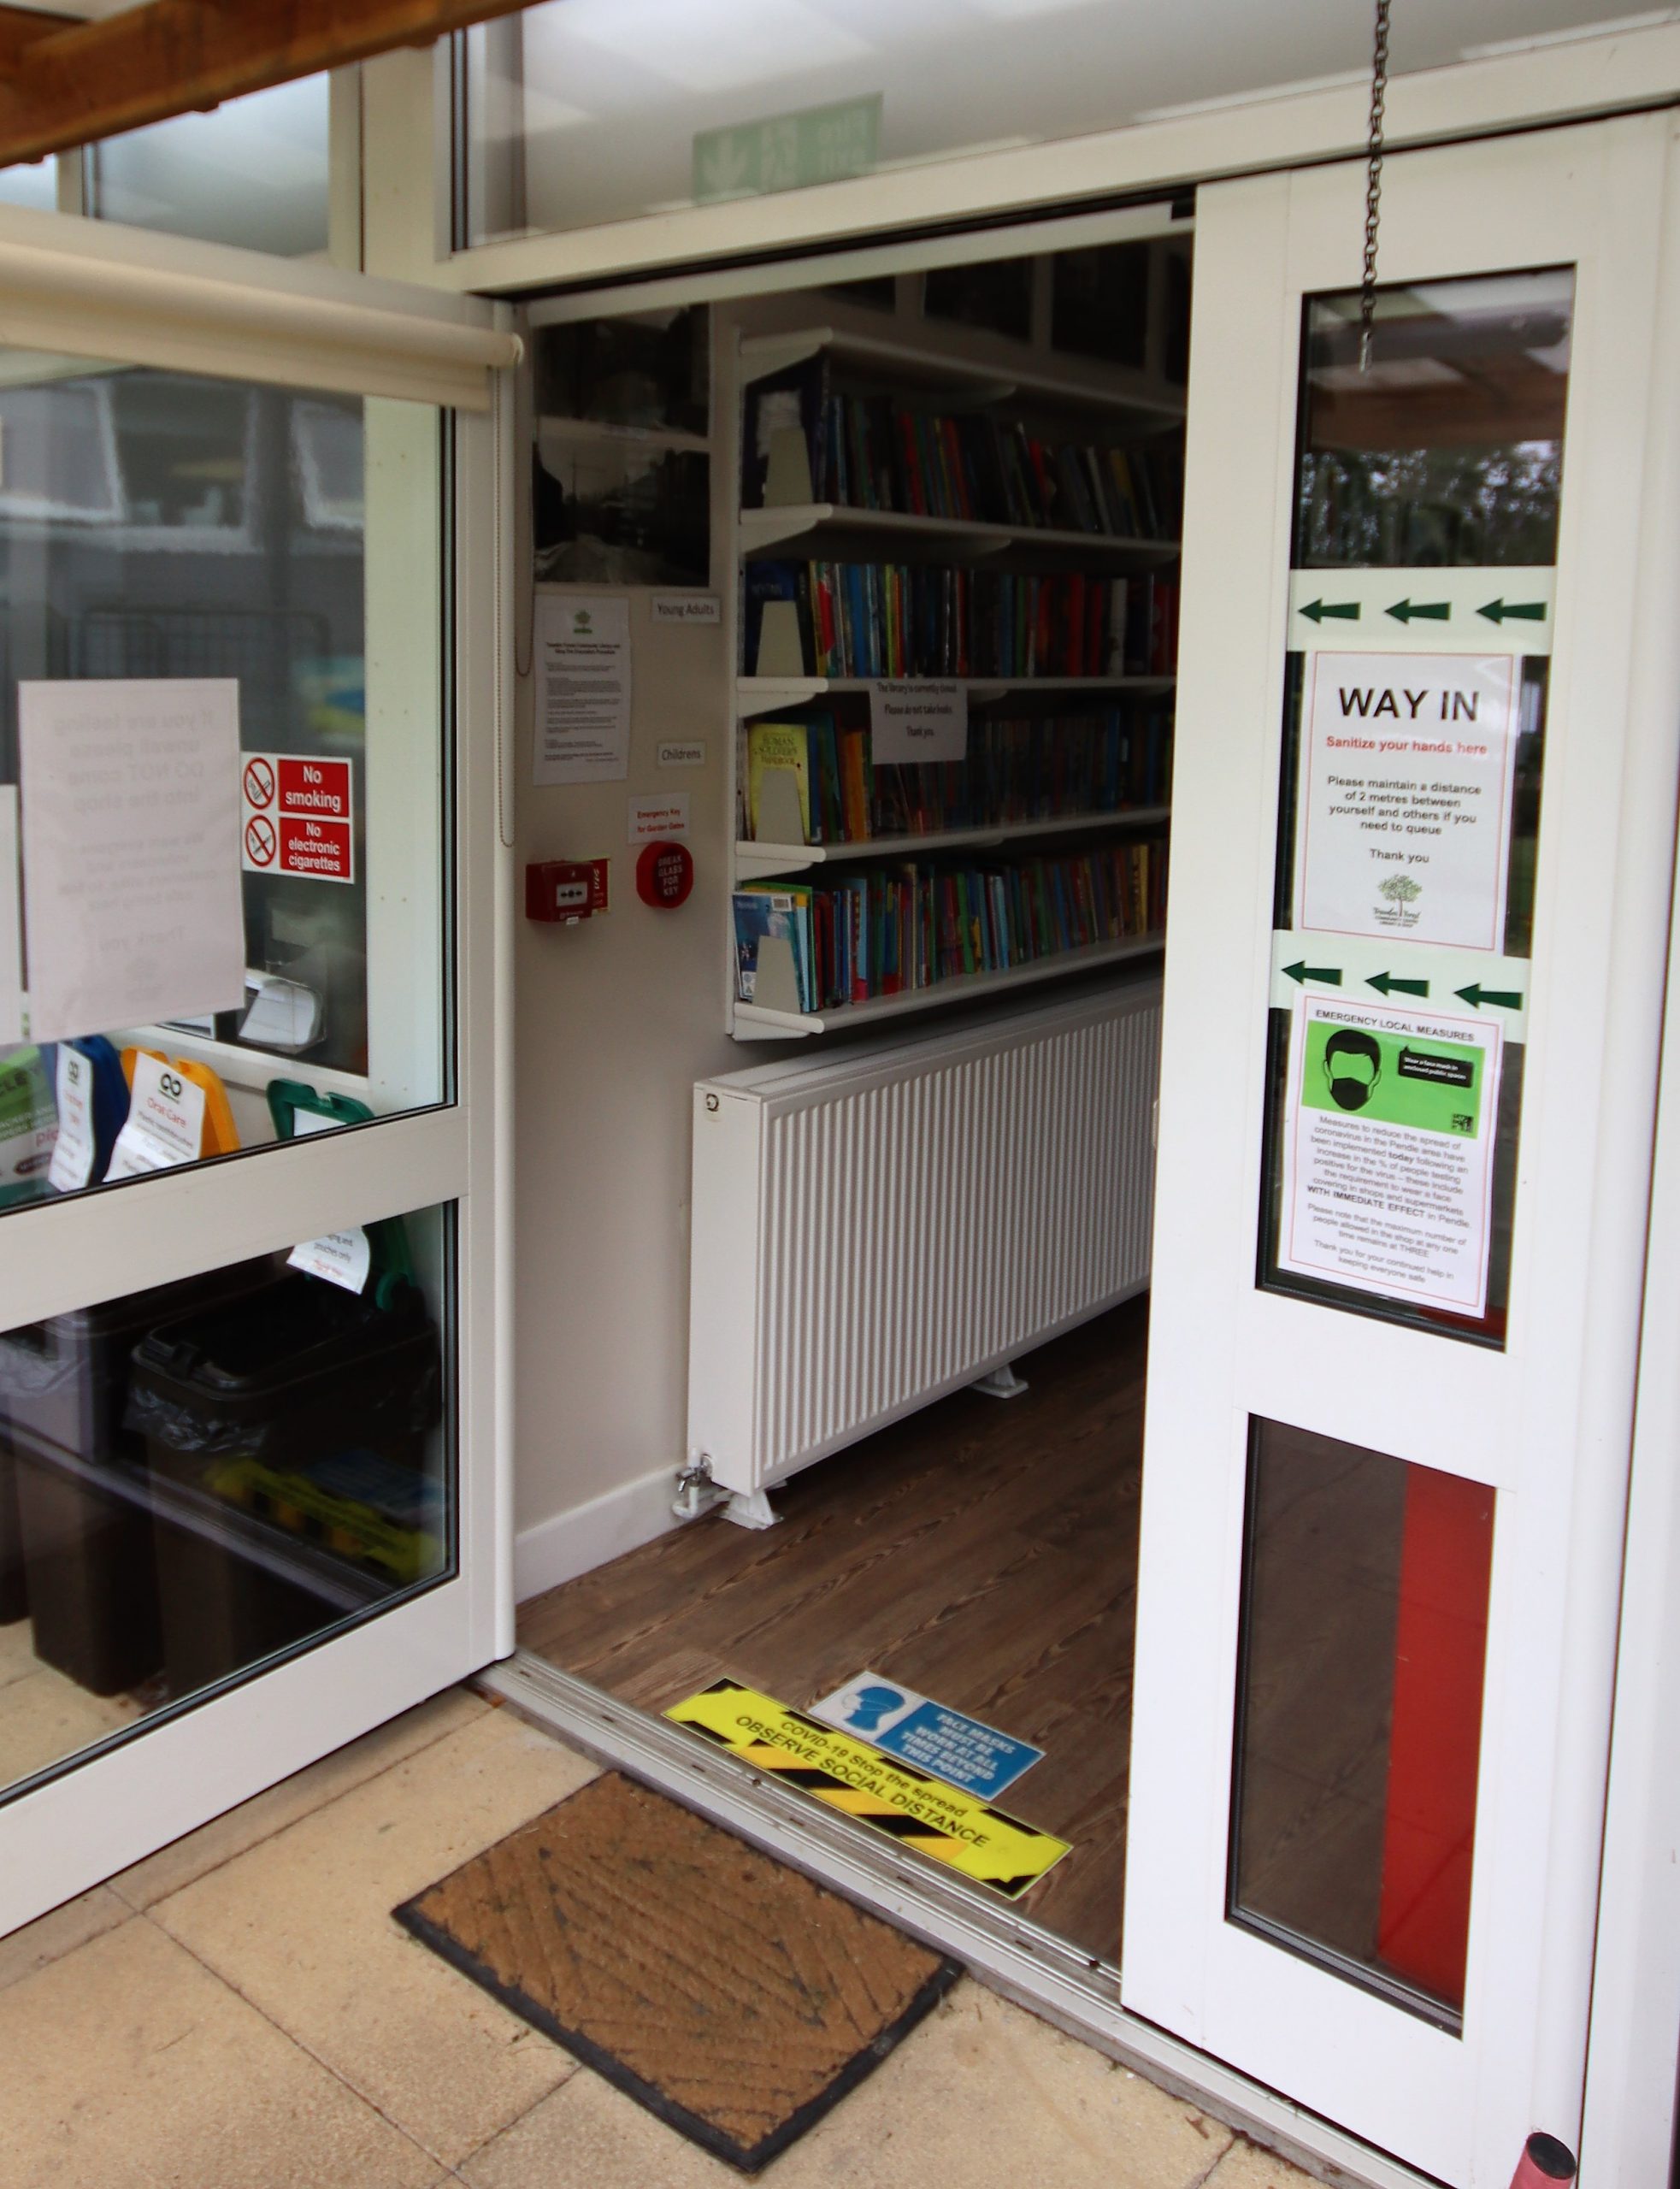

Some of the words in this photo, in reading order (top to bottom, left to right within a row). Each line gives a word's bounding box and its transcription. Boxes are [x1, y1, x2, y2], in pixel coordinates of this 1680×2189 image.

[657, 603, 684, 617] Young
[687, 604, 714, 615] Adults
[1339, 687, 1429, 719] WAY
[1440, 689, 1480, 722] IN
[1326, 736, 1376, 749] Sanitize
[1379, 741, 1408, 752] your
[1412, 740, 1453, 753] hands
[1458, 742, 1487, 754] here
[662, 748, 701, 761] Childrens
[303, 765, 322, 783] No
[1328, 775, 1365, 787] Please
[1368, 779, 1417, 790] maintain
[1431, 782, 1482, 794] distance
[286, 790, 341, 812] smoking
[1345, 791, 1357, 800] of
[1359, 792, 1365, 801] 2
[1370, 794, 1408, 804] metres
[1412, 795, 1461, 807] between
[1329, 805, 1375, 816] yourself
[1378, 807, 1400, 817] and
[1403, 809, 1440, 821] others
[1443, 811, 1452, 821] if
[1455, 815, 1477, 824] you
[306, 823, 321, 837] No
[1360, 821, 1388, 830] need
[1392, 822, 1402, 831] to
[1406, 825, 1441, 835] queue
[288, 837, 339, 855] electronic
[288, 854, 340, 871] cigarettes
[658, 855, 681, 867] BREAK
[1371, 848, 1404, 861] Thank
[1408, 854, 1429, 864] you
[658, 866, 682, 876] GLASS
[663, 877, 678, 887] FOR
[663, 887, 678, 897] KEY
[1316, 1009, 1377, 1026] EMERGENCY
[1380, 1019, 1413, 1033] LOCAL
[1417, 1026, 1475, 1041] MEASURES
[1314, 1127, 1361, 1142] coronavirus
[1374, 1137, 1387, 1146] the
[1320, 1116, 1359, 1130] Measures
[1372, 1127, 1400, 1138] reduce
[1404, 1133, 1417, 1142] the
[1419, 1137, 1450, 1148] spread
[1312, 1136, 1330, 1145] been
[1333, 1141, 1386, 1157] implemented
[1388, 1152, 1414, 1164] today
[1307, 1185, 1330, 1195] WITH
[1333, 1191, 1384, 1209] IMMEDIATE
[1388, 1203, 1424, 1218] EFFECT
[1308, 1203, 1333, 1214] Please
[781, 1721, 849, 1758] COVID-19
[849, 1755, 883, 1777] Stop
[886, 1773, 911, 1790] the
[912, 1788, 969, 1818] spread
[736, 1716, 820, 1762] OBSERVE
[819, 1758, 886, 1798] SOCIAL
[890, 1793, 990, 1848] DISTANCE
